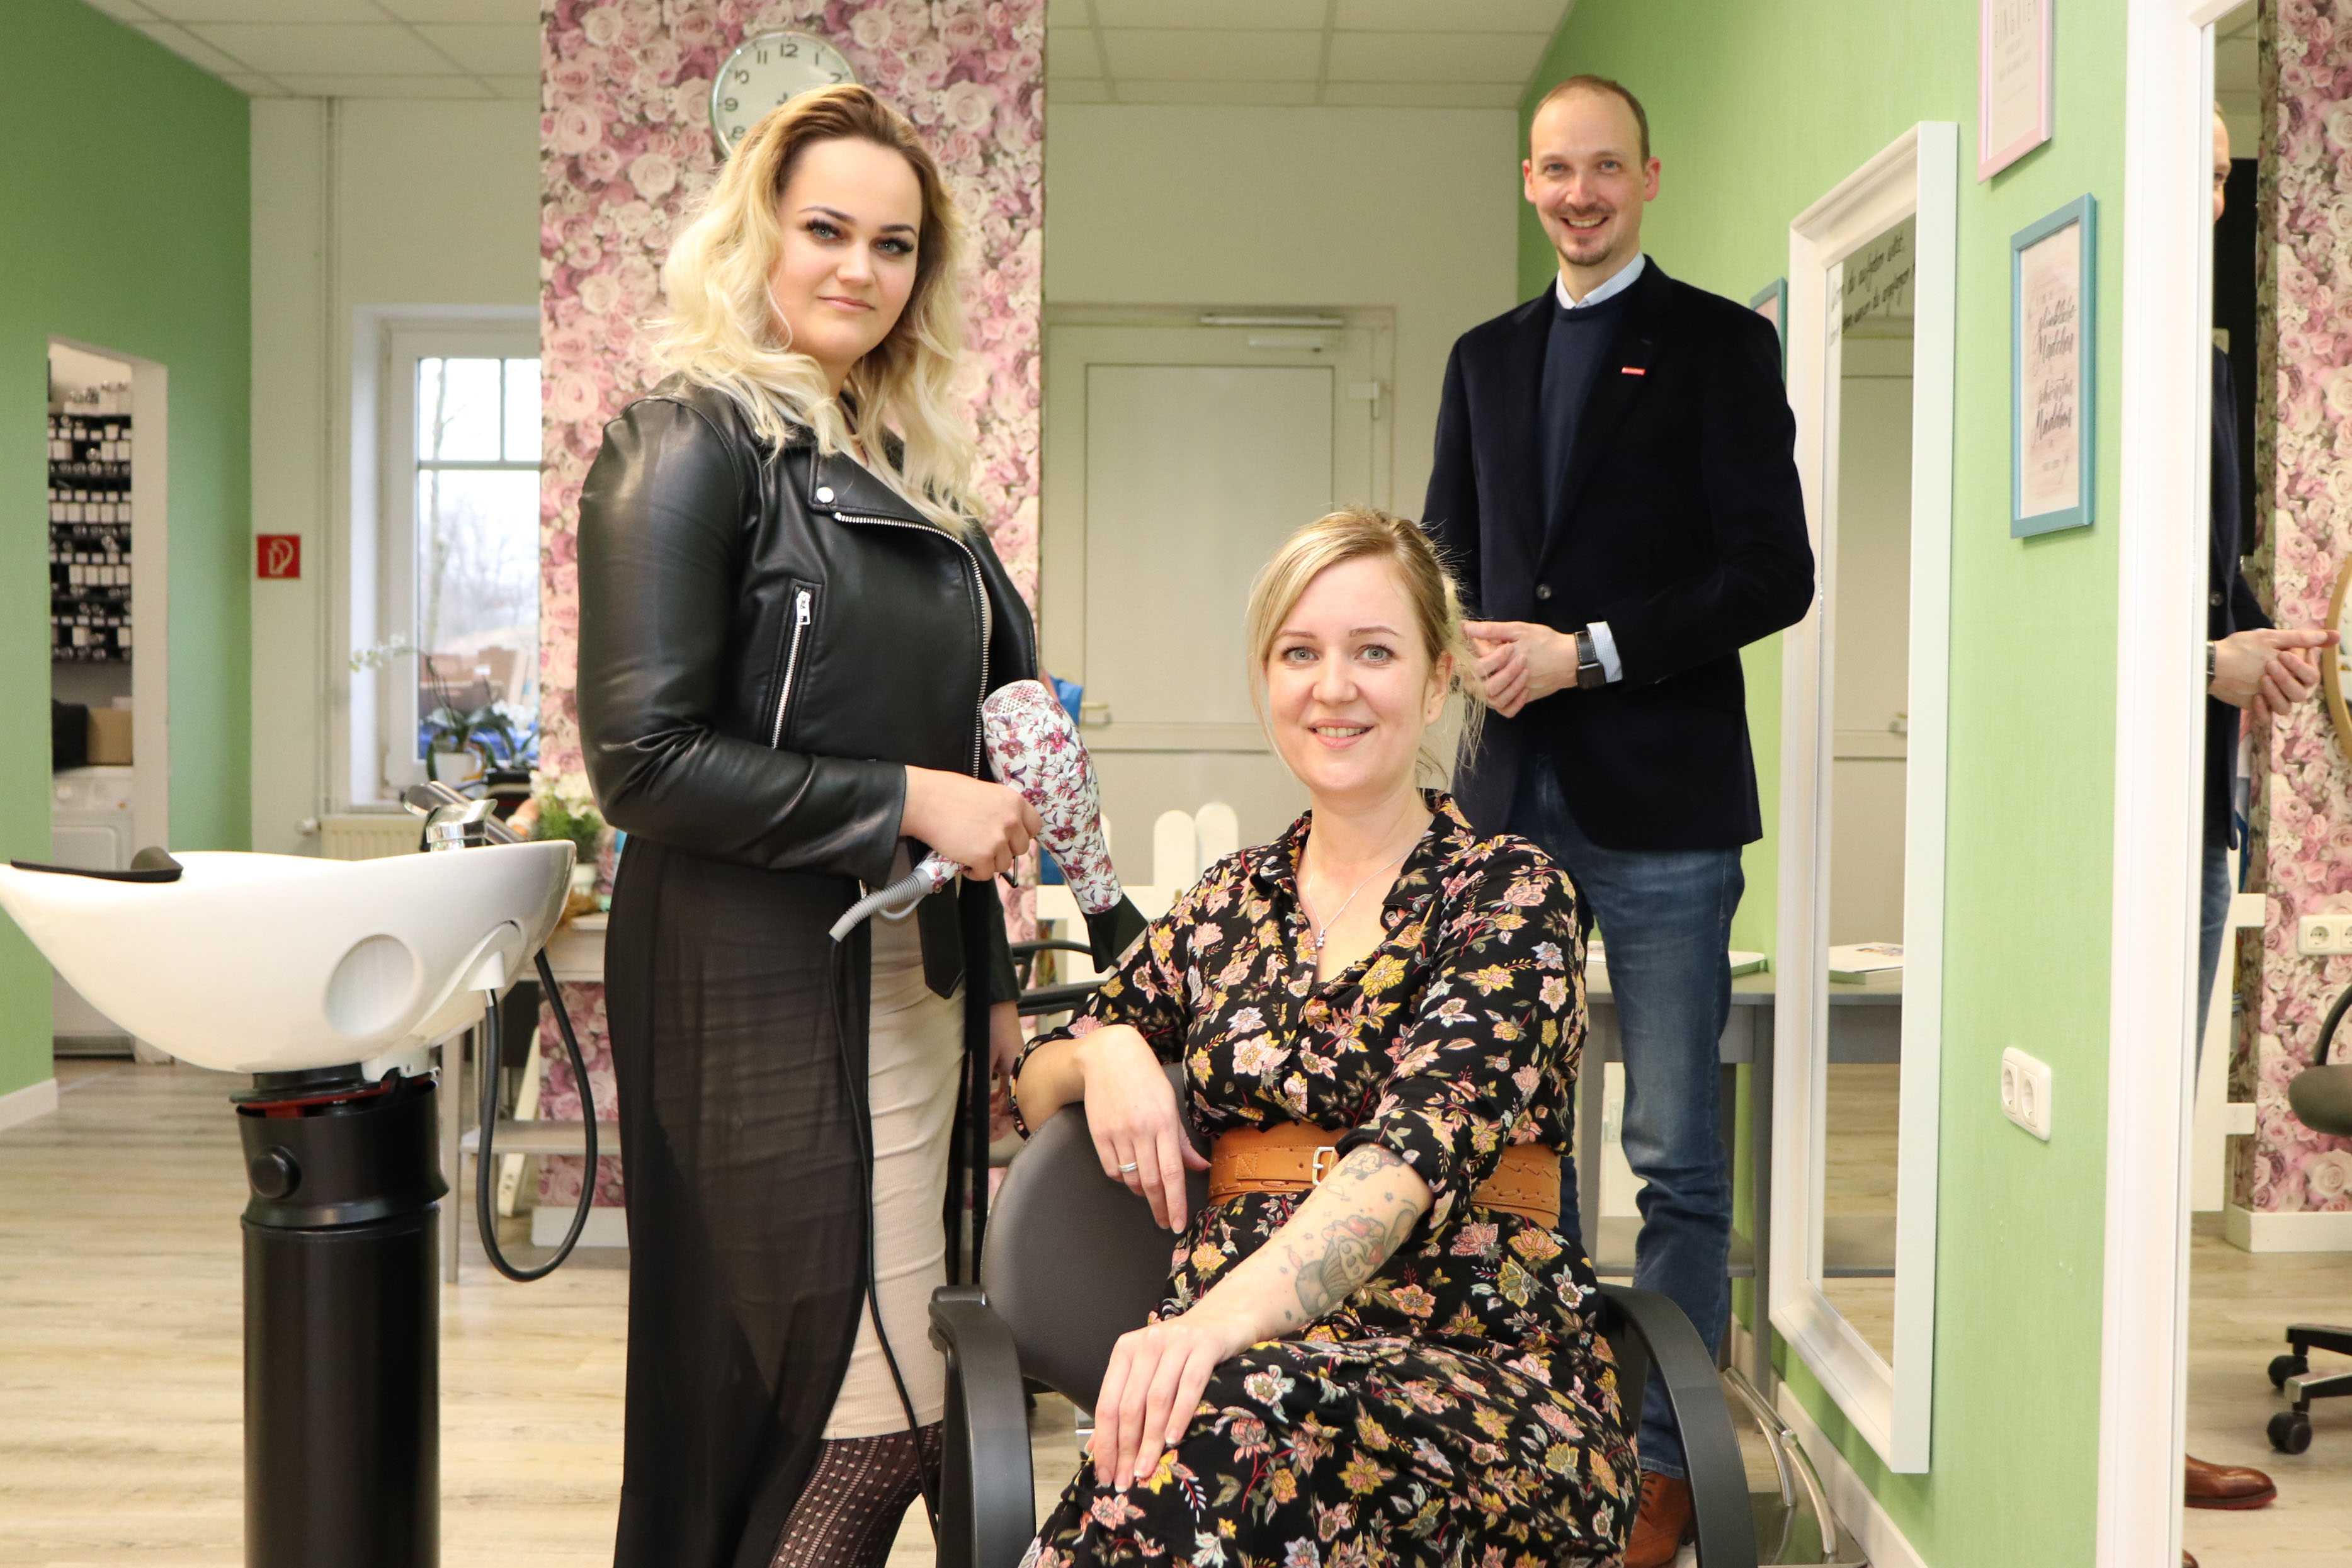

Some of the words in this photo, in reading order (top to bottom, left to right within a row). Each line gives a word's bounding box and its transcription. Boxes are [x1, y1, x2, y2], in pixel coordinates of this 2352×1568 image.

[757, 50, 768, 64] 11
[780, 43, 798, 58] 12
[734, 69, 749, 84] 10
[724, 97, 739, 112] 9
[731, 125, 746, 139] 8
